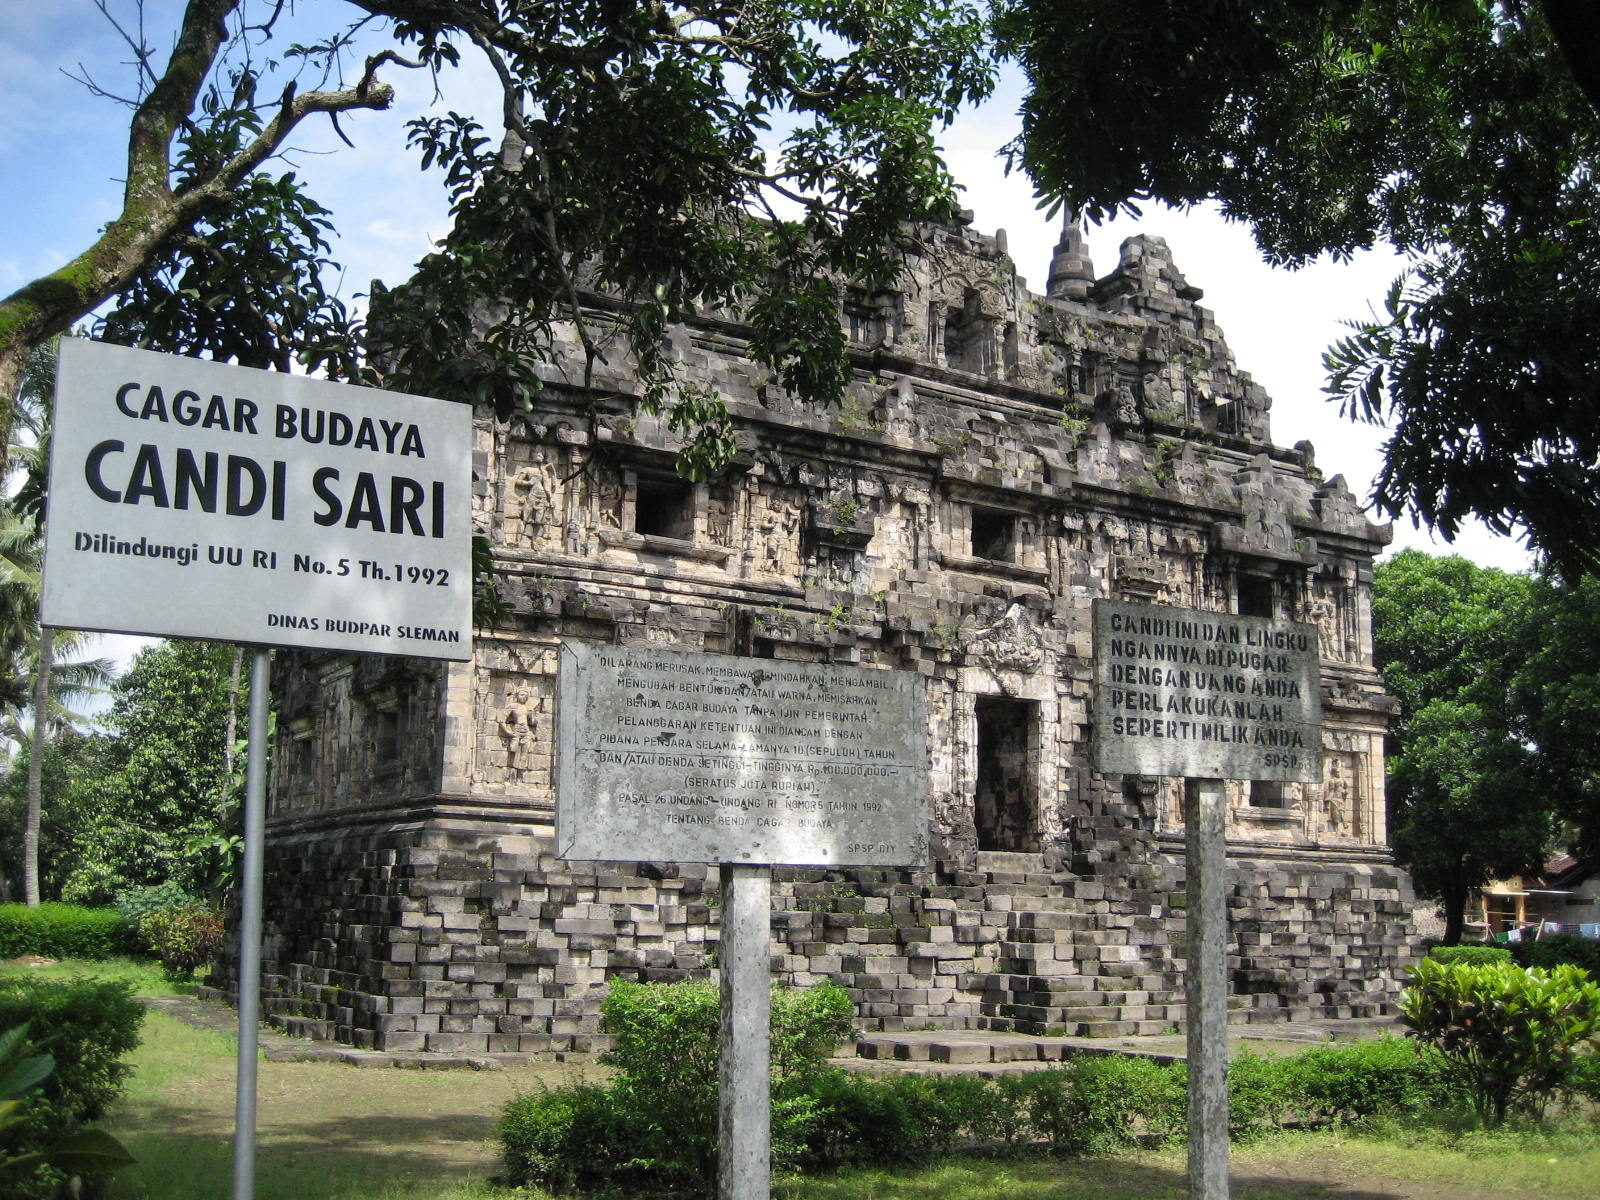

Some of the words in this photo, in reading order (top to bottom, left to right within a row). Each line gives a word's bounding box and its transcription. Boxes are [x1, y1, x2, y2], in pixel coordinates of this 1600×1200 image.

[116, 382, 258, 435] CAGAR
[275, 404, 426, 458] BUDAYA
[84, 439, 287, 521] CANDI
[312, 466, 444, 538] SARI
[74, 532, 198, 566] Dilindungi
[208, 545, 243, 567] UU
[252, 550, 277, 570] RI
[267, 613, 319, 632] DINAS
[325, 619, 391, 637] BUDPAR
[397, 625, 460, 643] SLEMAN
[1111, 613, 1170, 637] CANDI
[1175, 620, 1198, 640] INI
[1203, 624, 1240, 645] DAN
[1246, 629, 1308, 652] LINGKU
[1111, 639, 1200, 665] NGANNYA
[617, 678, 675, 692] MENGUBAH
[817, 693, 878, 706] MEMISAHKAN
[1111, 664, 1191, 688] DENGAN
[1195, 671, 1246, 694] UANG
[1251, 677, 1300, 699] ANDA
[665, 700, 698, 712] CAGAR
[702, 703, 738, 715] BUDAYA
[1111, 689, 1283, 722] PERLAKUKANLAH
[617, 716, 697, 731] PELANGGARAN
[700, 721, 761, 735] KETENTUAN
[779, 726, 821, 738] DIANCAM
[824, 728, 863, 740] DENGAN
[1112, 716, 1197, 740] SEPERTI
[1201, 722, 1249, 744] MILIK
[1254, 727, 1304, 748] ANDA
[658, 756, 695, 768] DENDA
[863, 749, 896, 760] TAHUN
[741, 780, 768, 791] JUTA
[863, 802, 882, 812] 1992
